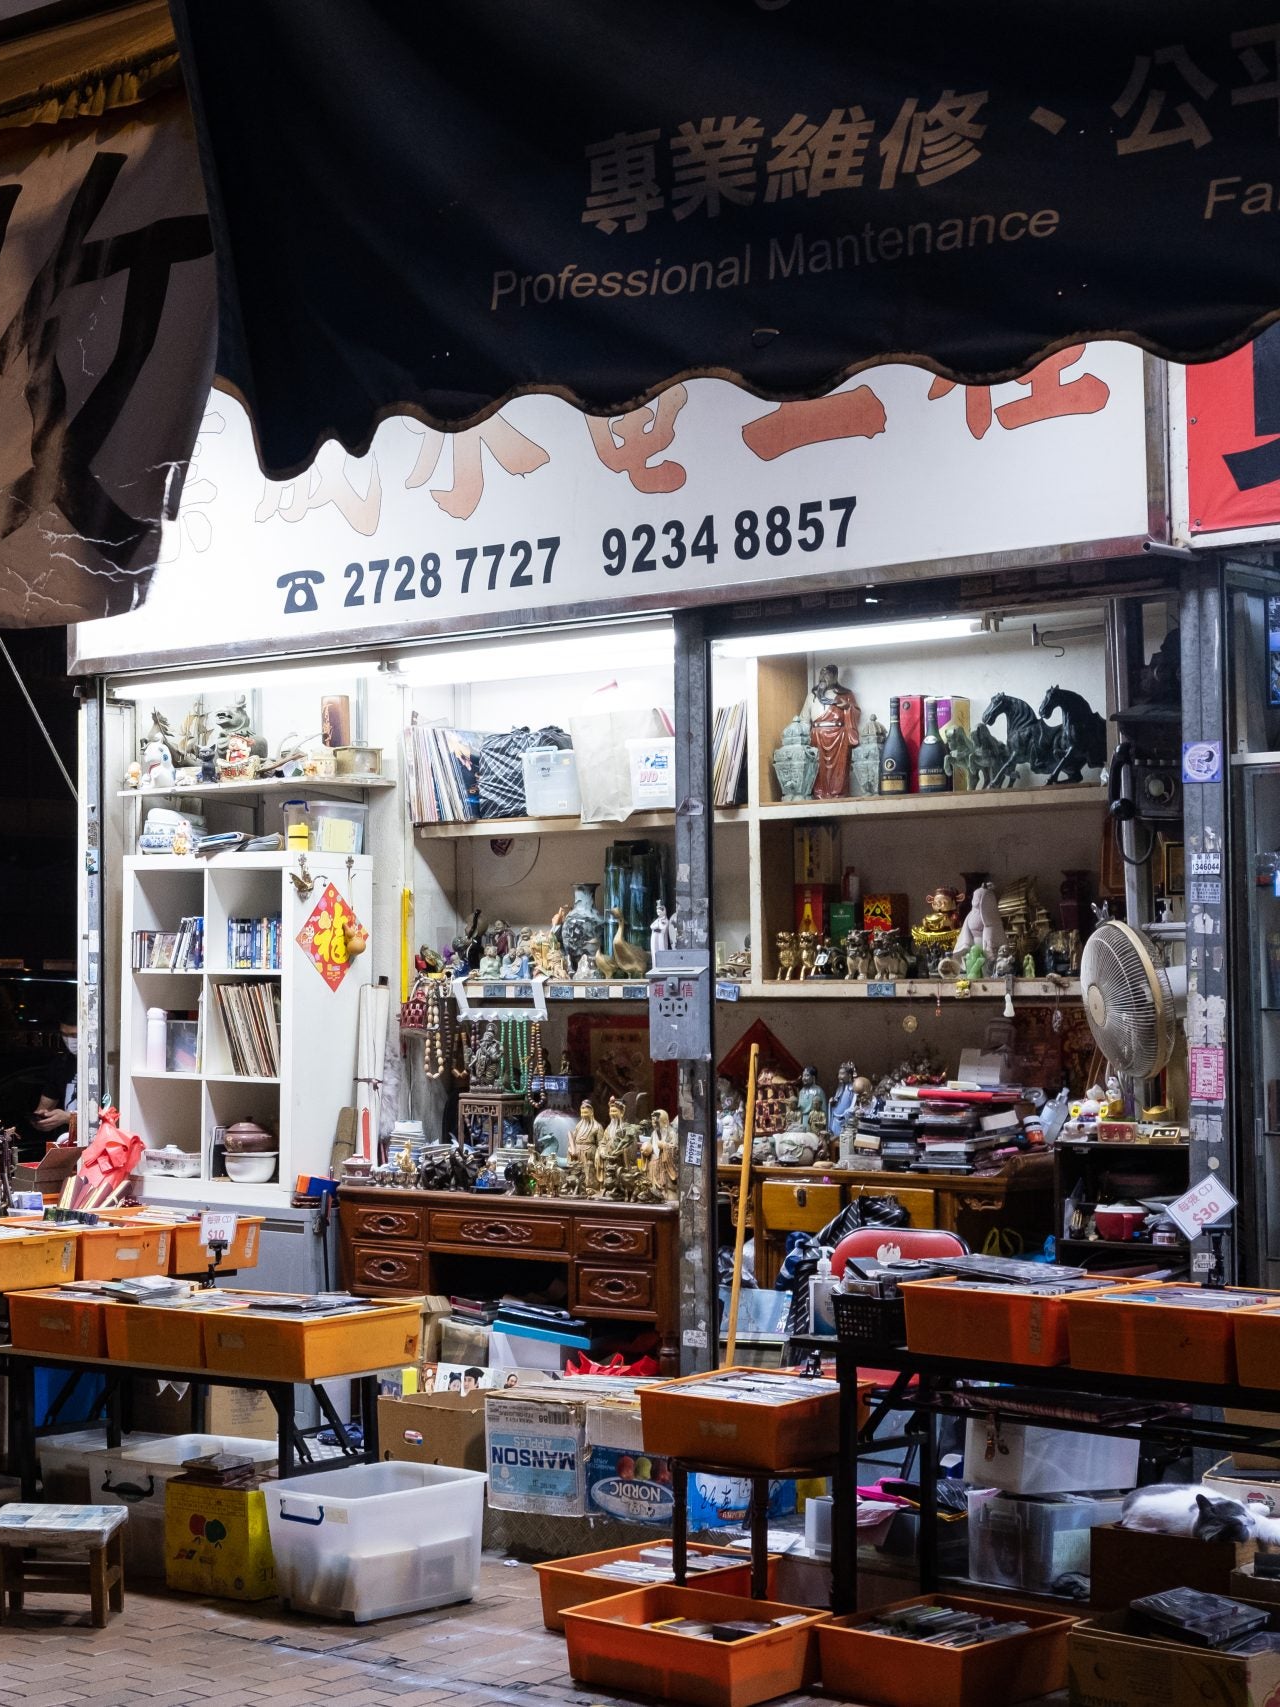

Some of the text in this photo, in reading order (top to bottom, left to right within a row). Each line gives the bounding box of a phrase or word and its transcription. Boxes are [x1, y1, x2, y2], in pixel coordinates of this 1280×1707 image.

[490, 176, 1280, 311] Professional Mantenance Fa
[343, 496, 857, 608] 2728 7727 9234 8857
[1198, 1183, 1213, 1197] CD
[1192, 1201, 1220, 1227] $30
[207, 1229, 225, 1241] $10
[513, 1436, 553, 1451] APPLES
[491, 1446, 576, 1471] MANSON
[609, 1480, 661, 1503] NORDIC
